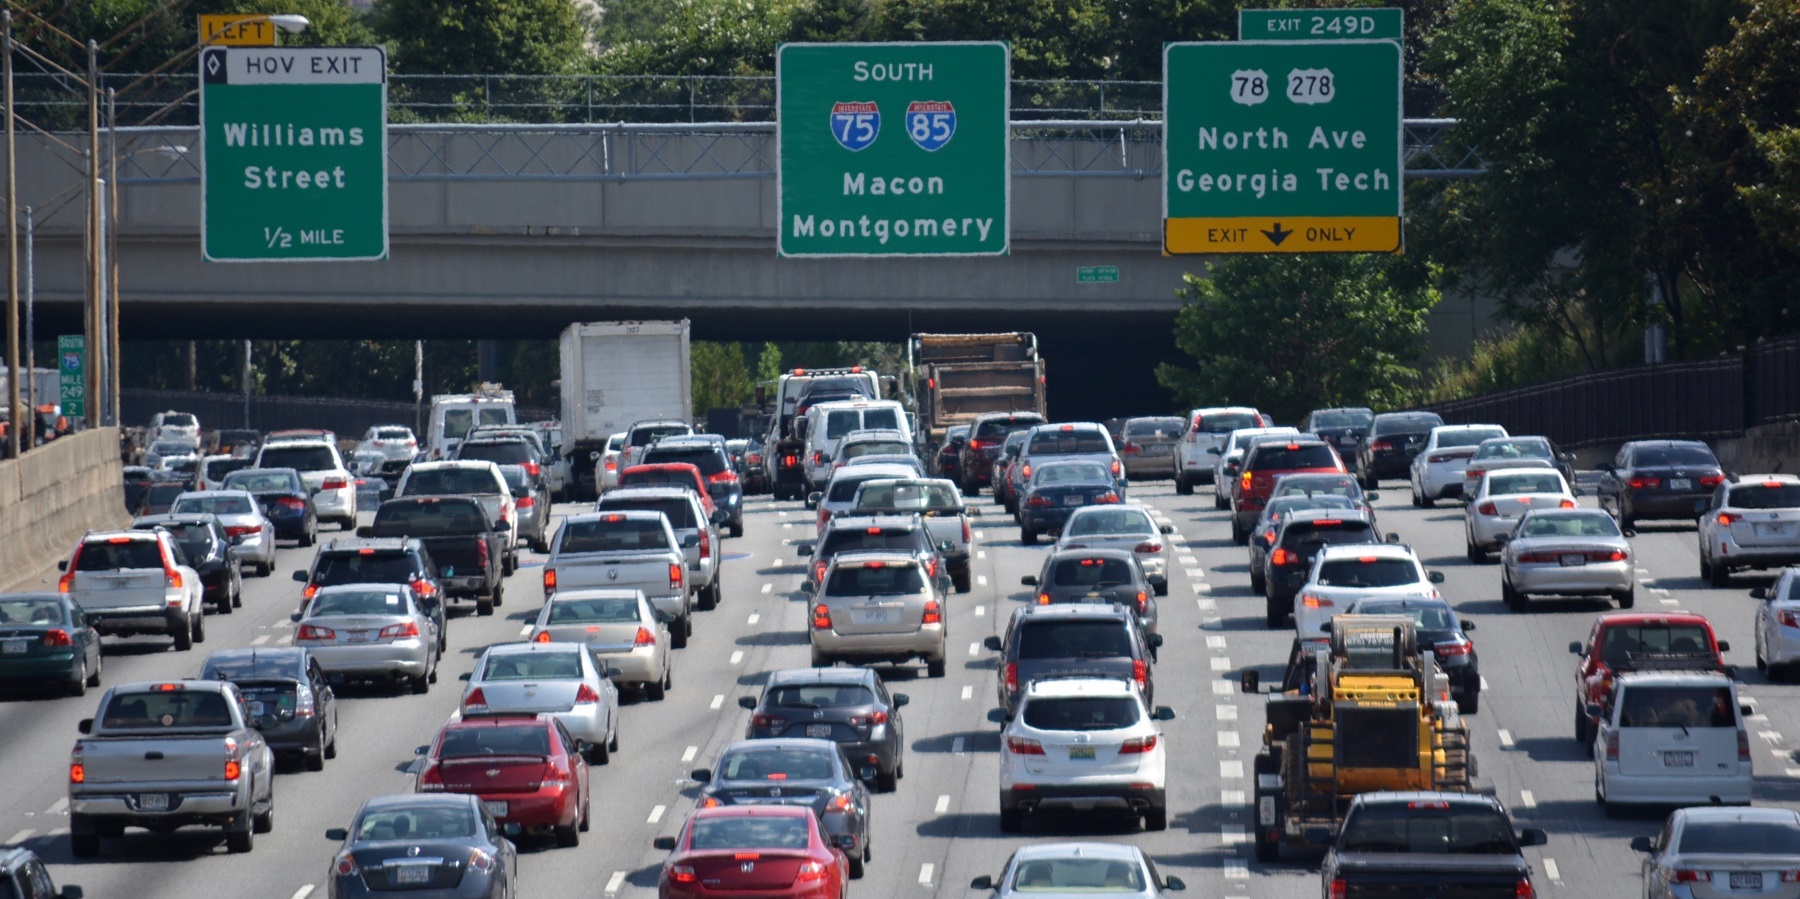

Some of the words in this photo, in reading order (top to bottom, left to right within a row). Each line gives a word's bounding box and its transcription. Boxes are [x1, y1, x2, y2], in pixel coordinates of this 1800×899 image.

[207, 22, 266, 40] LEFT
[1267, 19, 1301, 32] EXIT
[1310, 16, 1375, 35] 249D
[246, 56, 295, 74] HOV
[311, 56, 363, 74] EXIT
[853, 60, 933, 81] SOUTH
[1234, 76, 1265, 97] 78
[1291, 75, 1331, 97] 278
[838, 104, 873, 112] INTERSTATE
[913, 104, 948, 112] INTERSTATE
[223, 122, 364, 147] Williams
[836, 113, 874, 142] 75
[911, 113, 951, 142] 85
[1198, 126, 1288, 150] North
[1308, 125, 1367, 150] Ave
[243, 165, 345, 189] Street
[843, 171, 944, 196] Macon
[1176, 168, 1298, 199] Georgia
[1316, 167, 1390, 191] Tech
[300, 229, 345, 245] MILE
[793, 213, 993, 244] Montgomery
[1207, 228, 1248, 242] EXIT
[1306, 227, 1356, 242] ONLY
[64, 356, 80, 369] 75
[61, 375, 82, 385] MILE
[61, 386, 83, 398] 249
